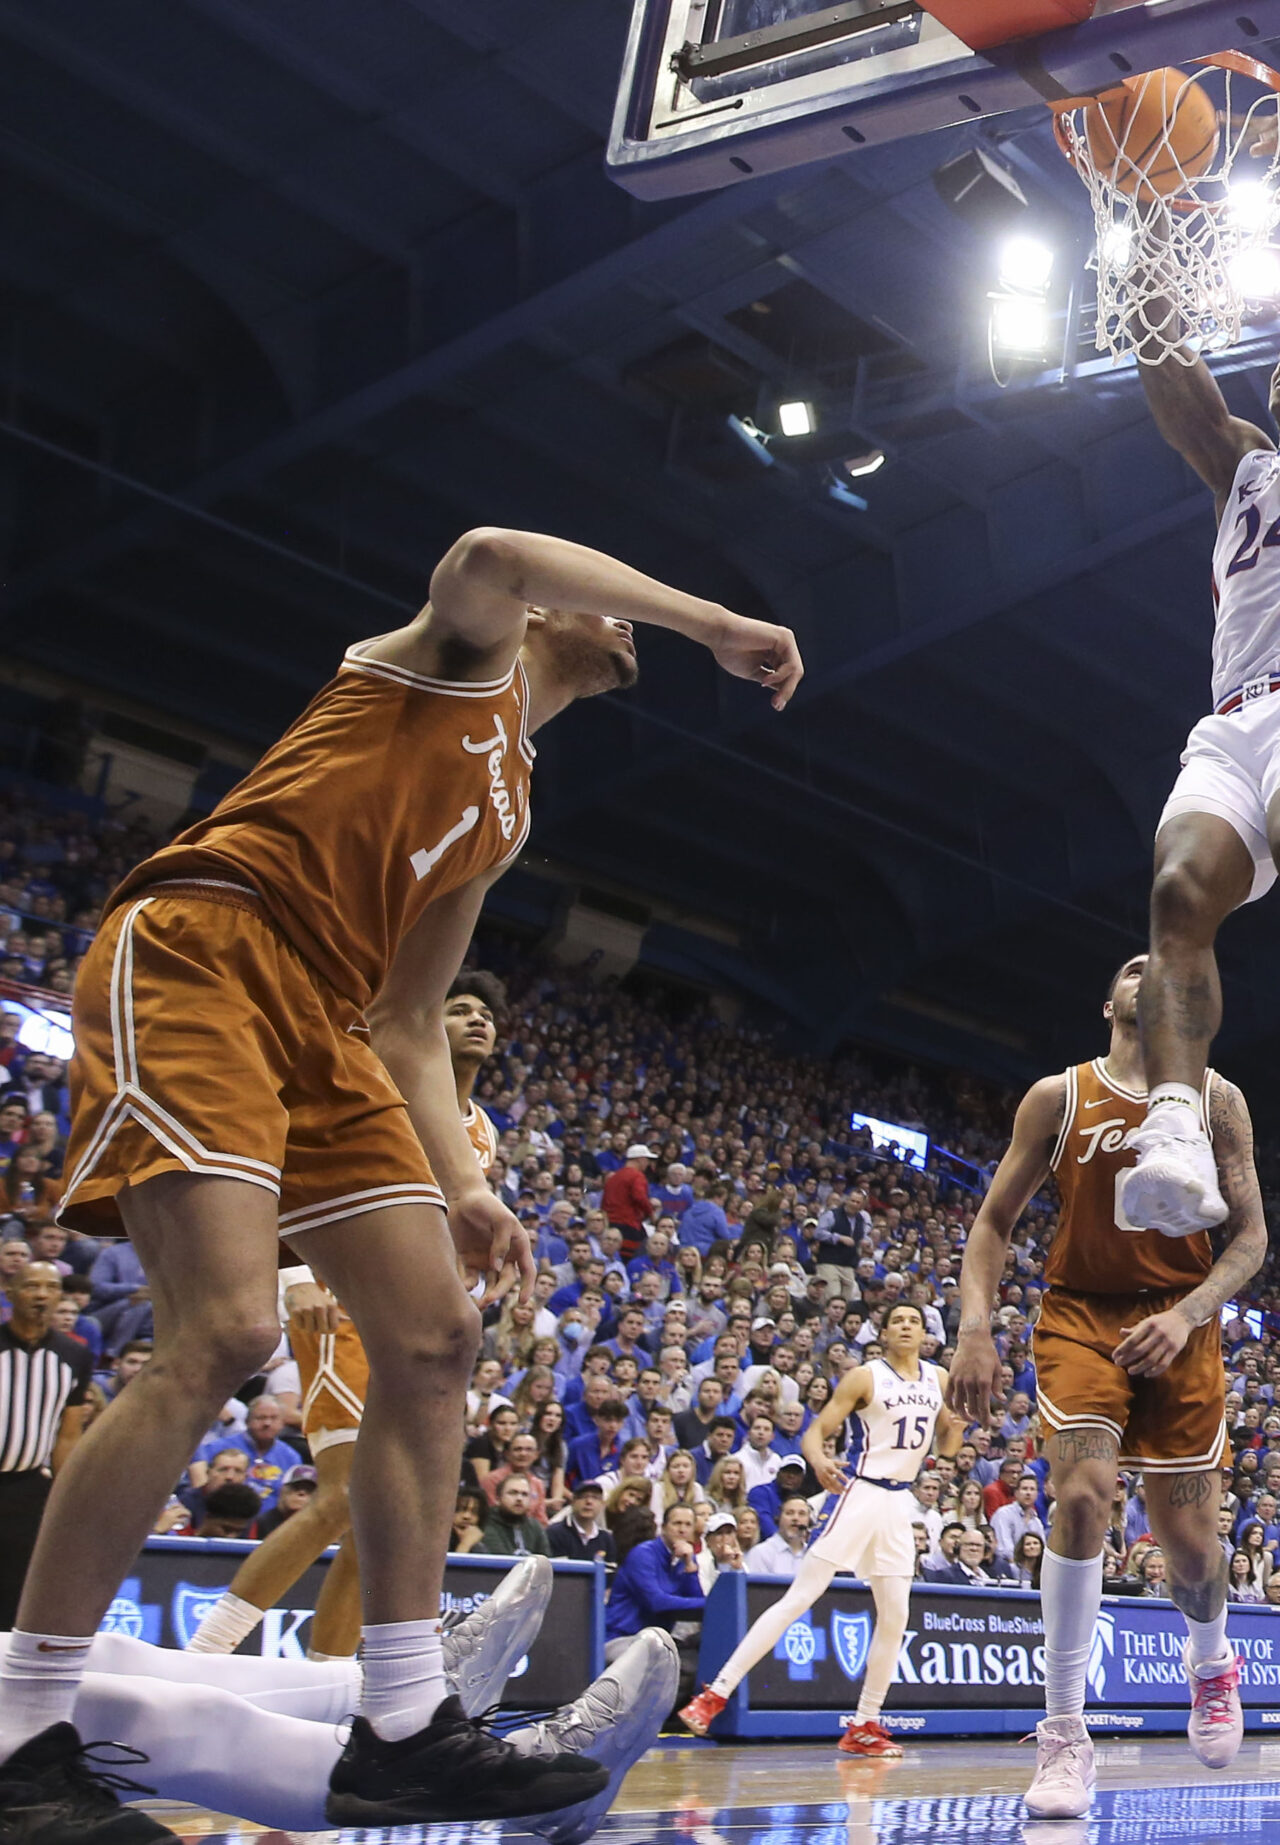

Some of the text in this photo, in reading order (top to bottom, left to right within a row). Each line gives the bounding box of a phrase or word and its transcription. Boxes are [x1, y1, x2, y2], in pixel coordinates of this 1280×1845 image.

[1245, 682, 1265, 700] KU
[409, 806, 480, 881] 1
[1077, 1118, 1142, 1164] Tex
[883, 1394, 939, 1412] KANSAS
[891, 1415, 929, 1450] 15
[923, 1611, 985, 1633] BlueCross
[890, 1630, 1048, 1686] Kansas
[1120, 1630, 1156, 1657] THE
[1254, 1638, 1274, 1660] OF
[1123, 1658, 1188, 1685] KANSAS
